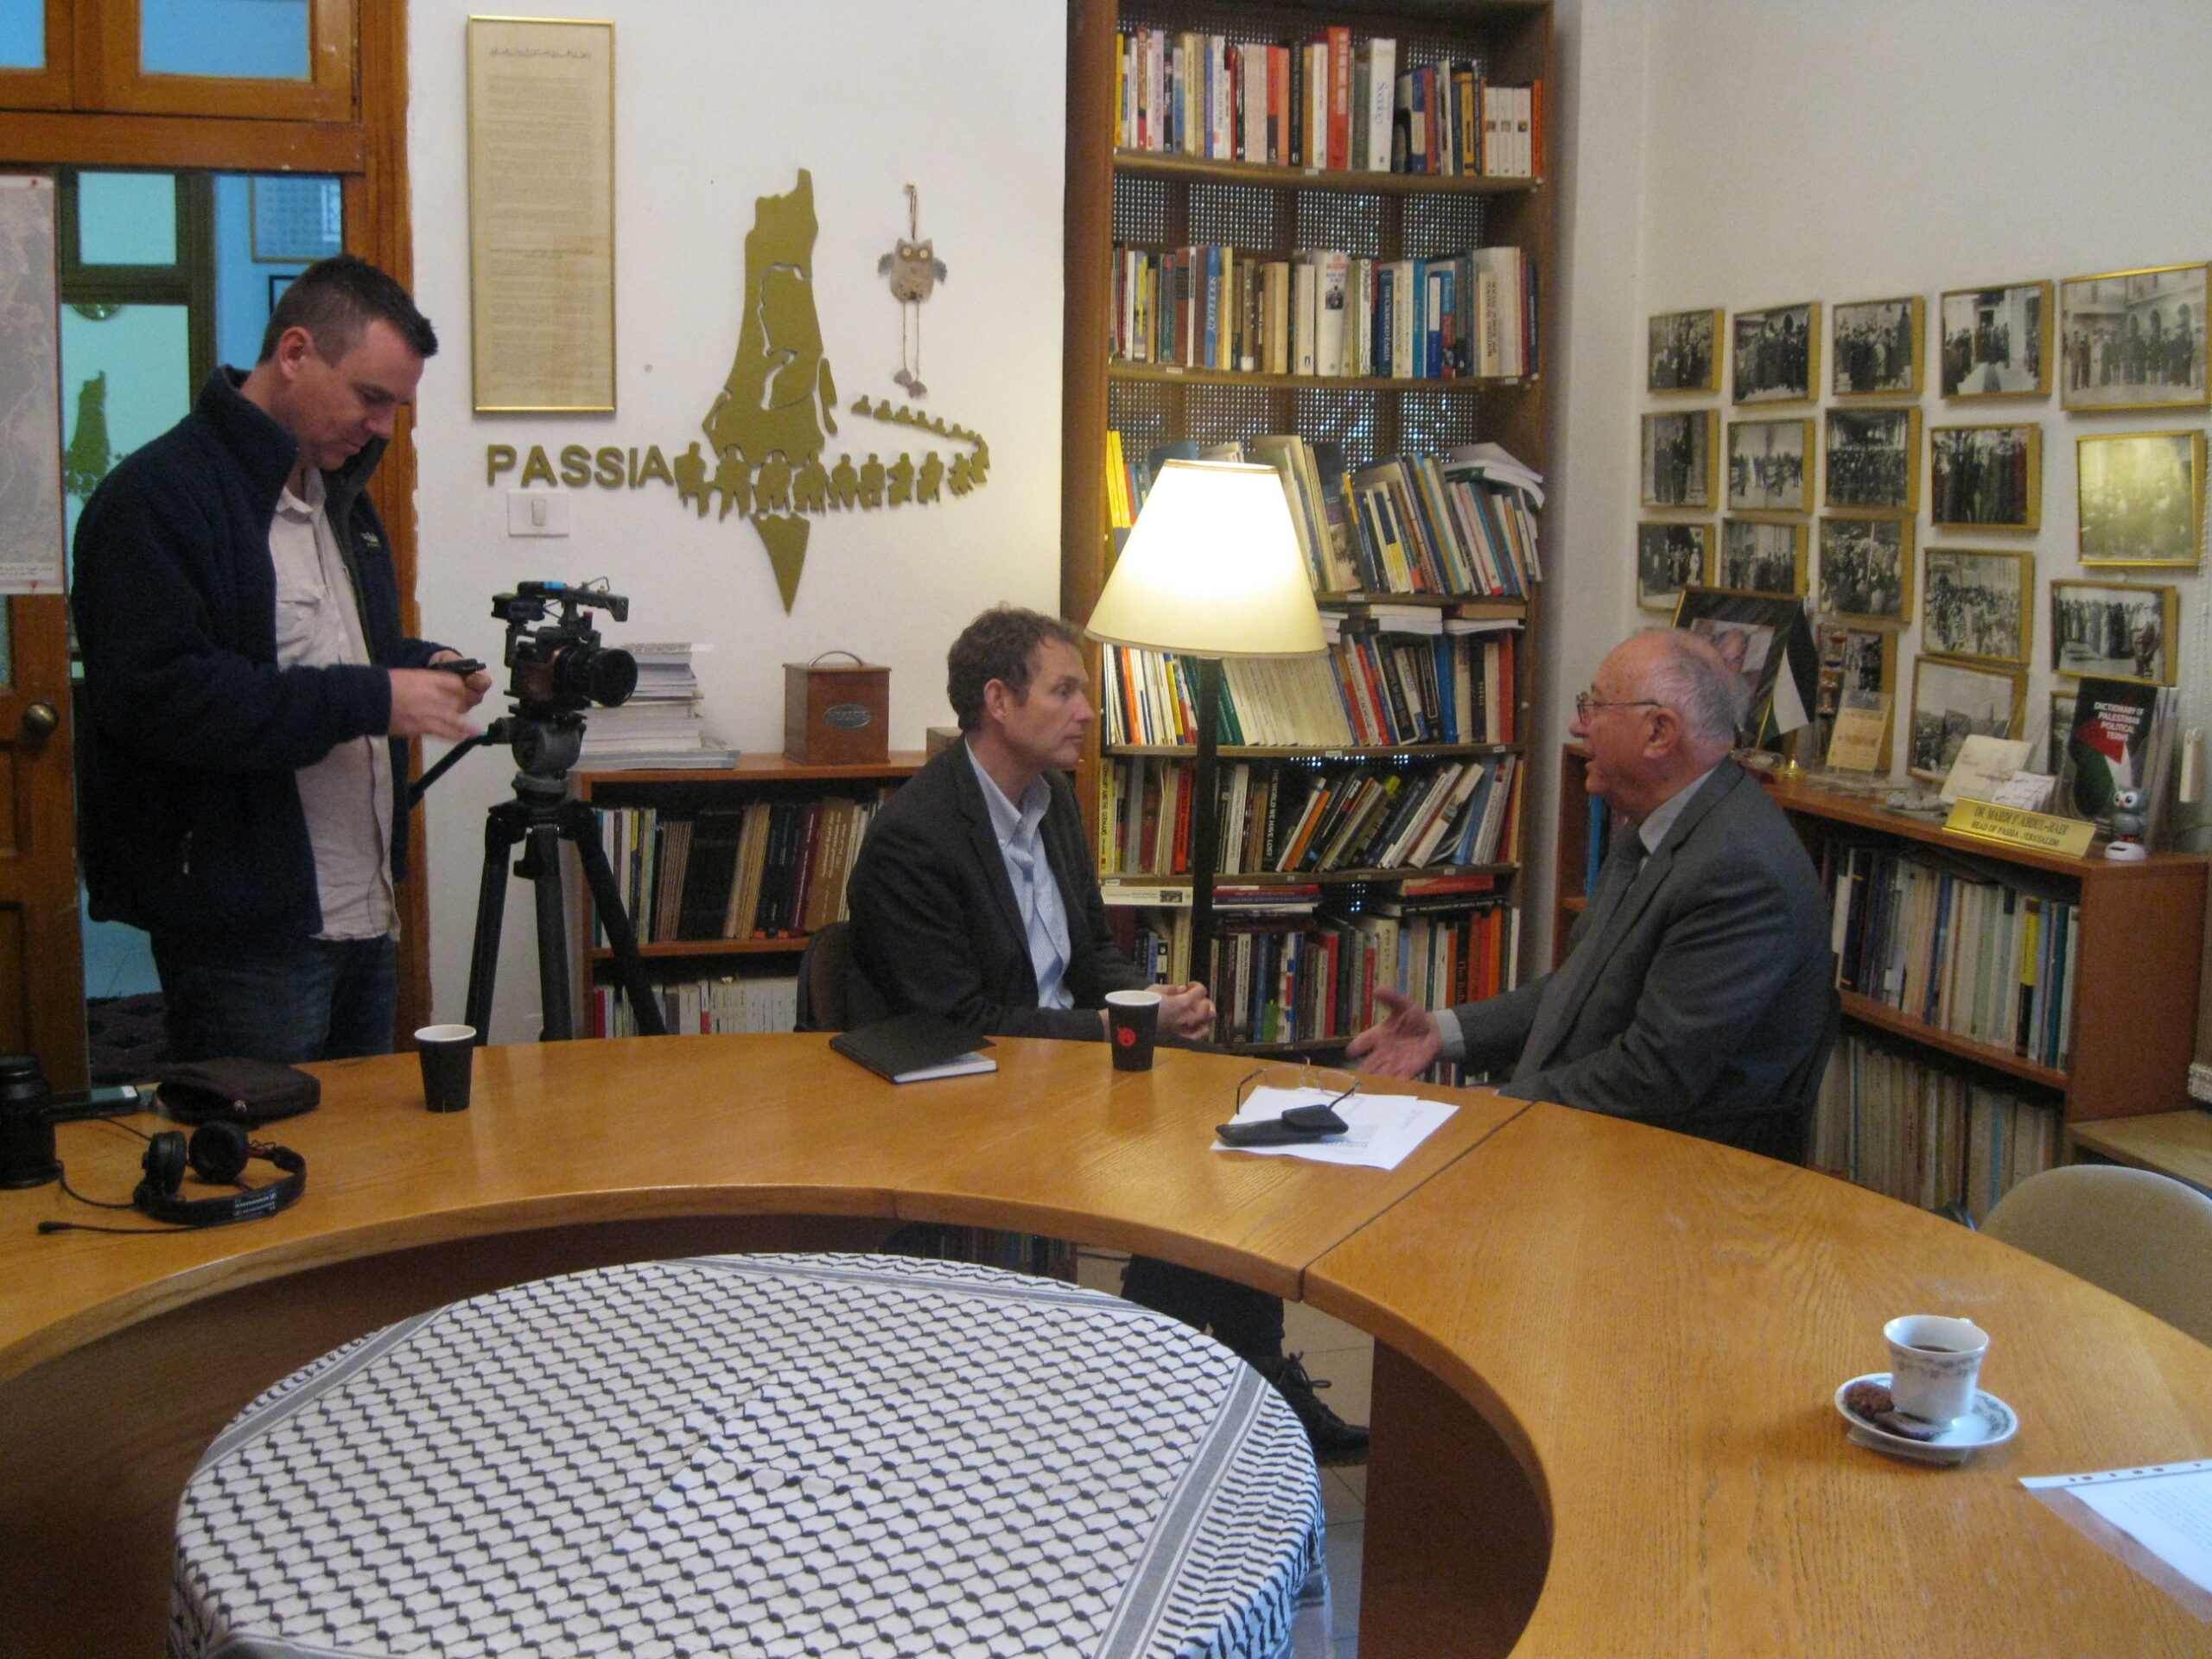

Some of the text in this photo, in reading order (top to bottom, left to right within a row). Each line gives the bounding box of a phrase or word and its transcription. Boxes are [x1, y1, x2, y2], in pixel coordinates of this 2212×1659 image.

[1374, 82, 1387, 126] Sociology
[1207, 275, 1217, 333] SOCIOLOGY
[486, 443, 676, 489] PASSIA
[2094, 702, 2145, 716] DICTIONARY OF
[2098, 711, 2141, 725] PALESTINIAN
[2101, 721, 2135, 734] POLITICAL
[2107, 730, 2129, 741] TERMS
[1268, 809, 1276, 819] WE
[1988, 810, 2012, 823] MAHDI
[1971, 822, 1986, 831] HEAD
[2020, 832, 2059, 847] JERUSALEM
